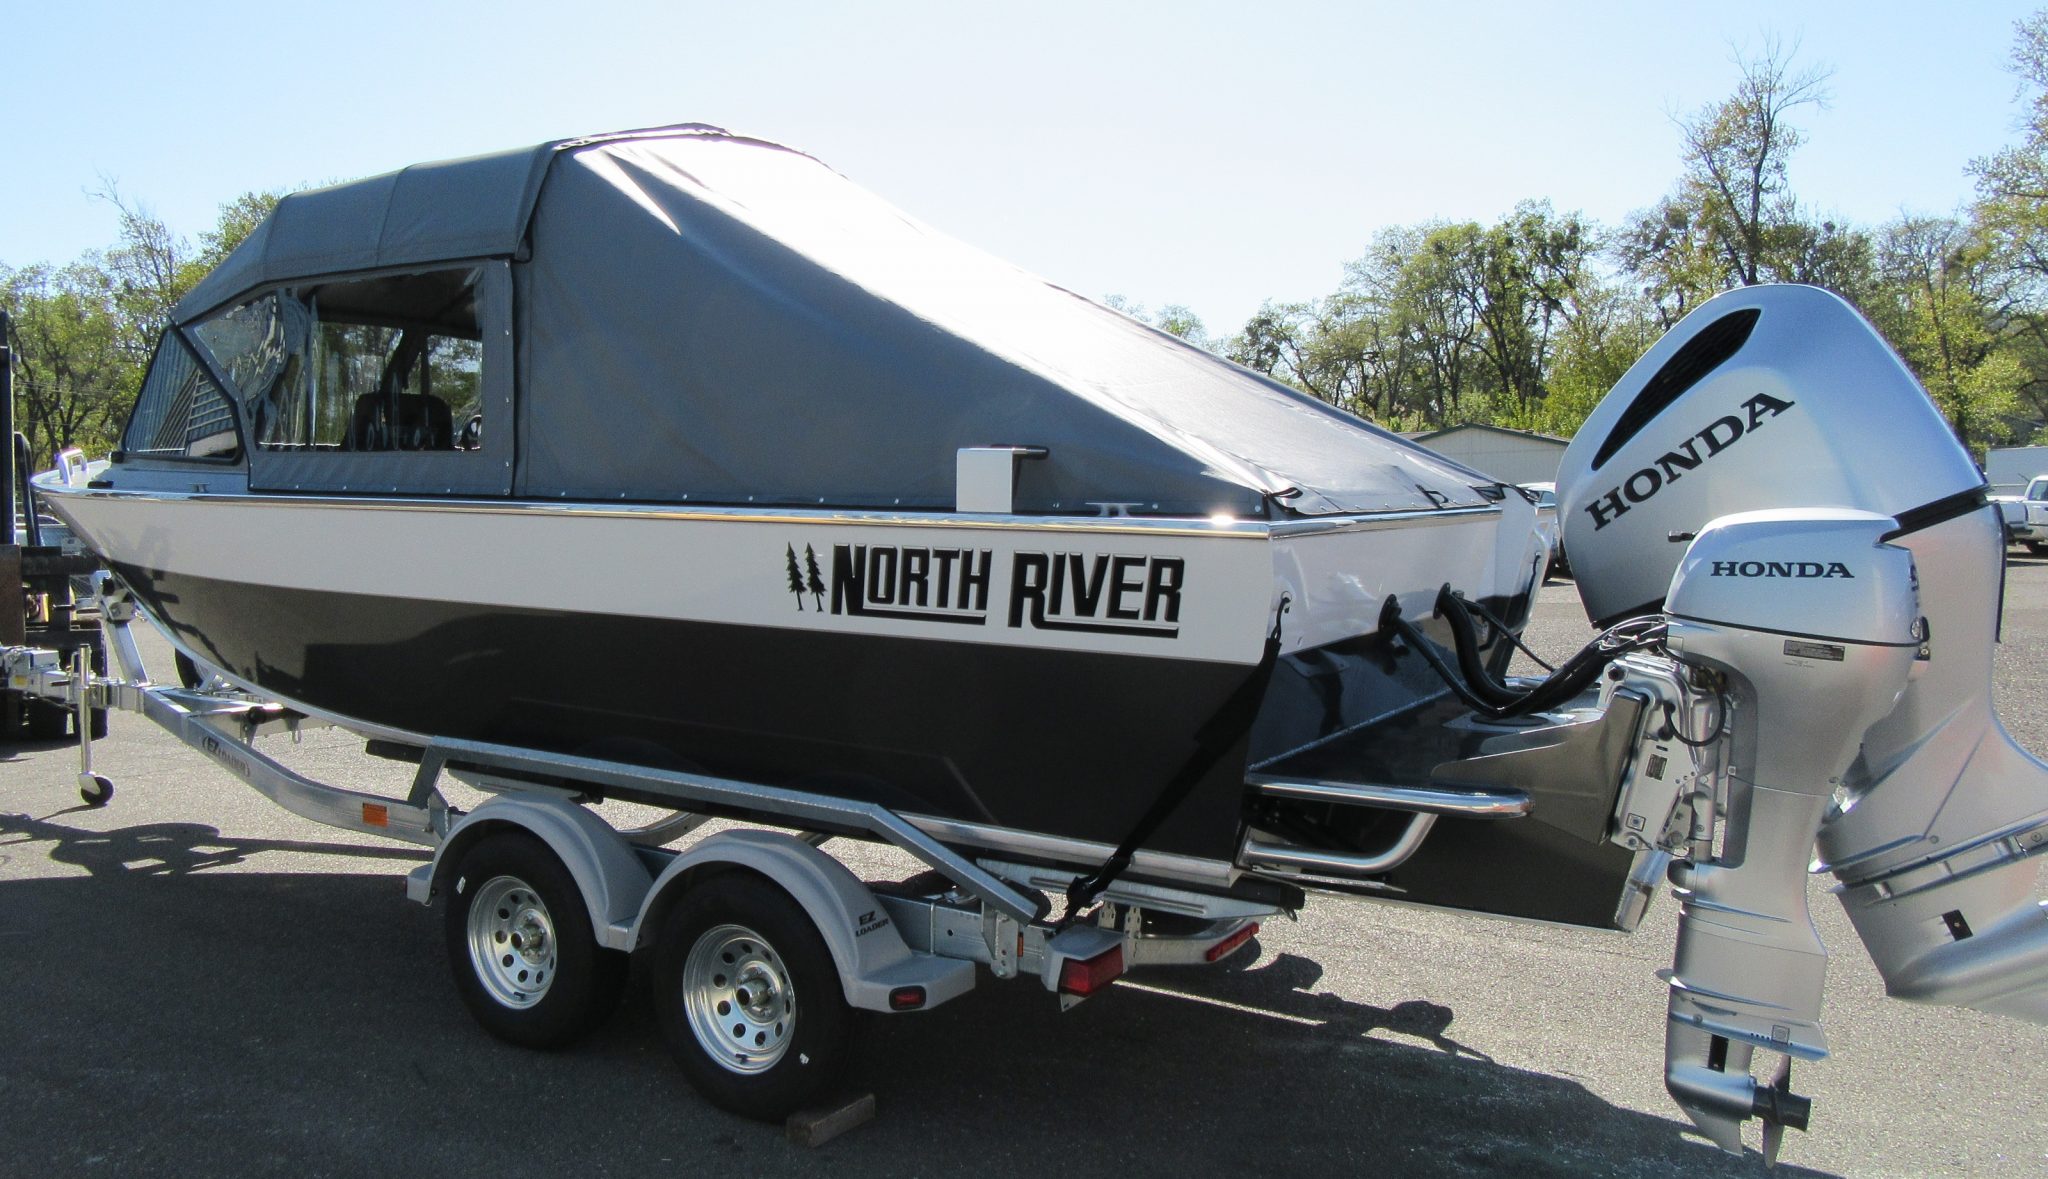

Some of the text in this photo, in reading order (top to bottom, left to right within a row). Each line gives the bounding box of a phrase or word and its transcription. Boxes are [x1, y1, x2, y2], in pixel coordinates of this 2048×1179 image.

[1584, 392, 1796, 532] HONDA
[1710, 561, 1855, 579] HONDA
[831, 542, 1185, 638] NORTH RIVER
[858, 910, 877, 925] EZ
[856, 918, 889, 937] LOADER
